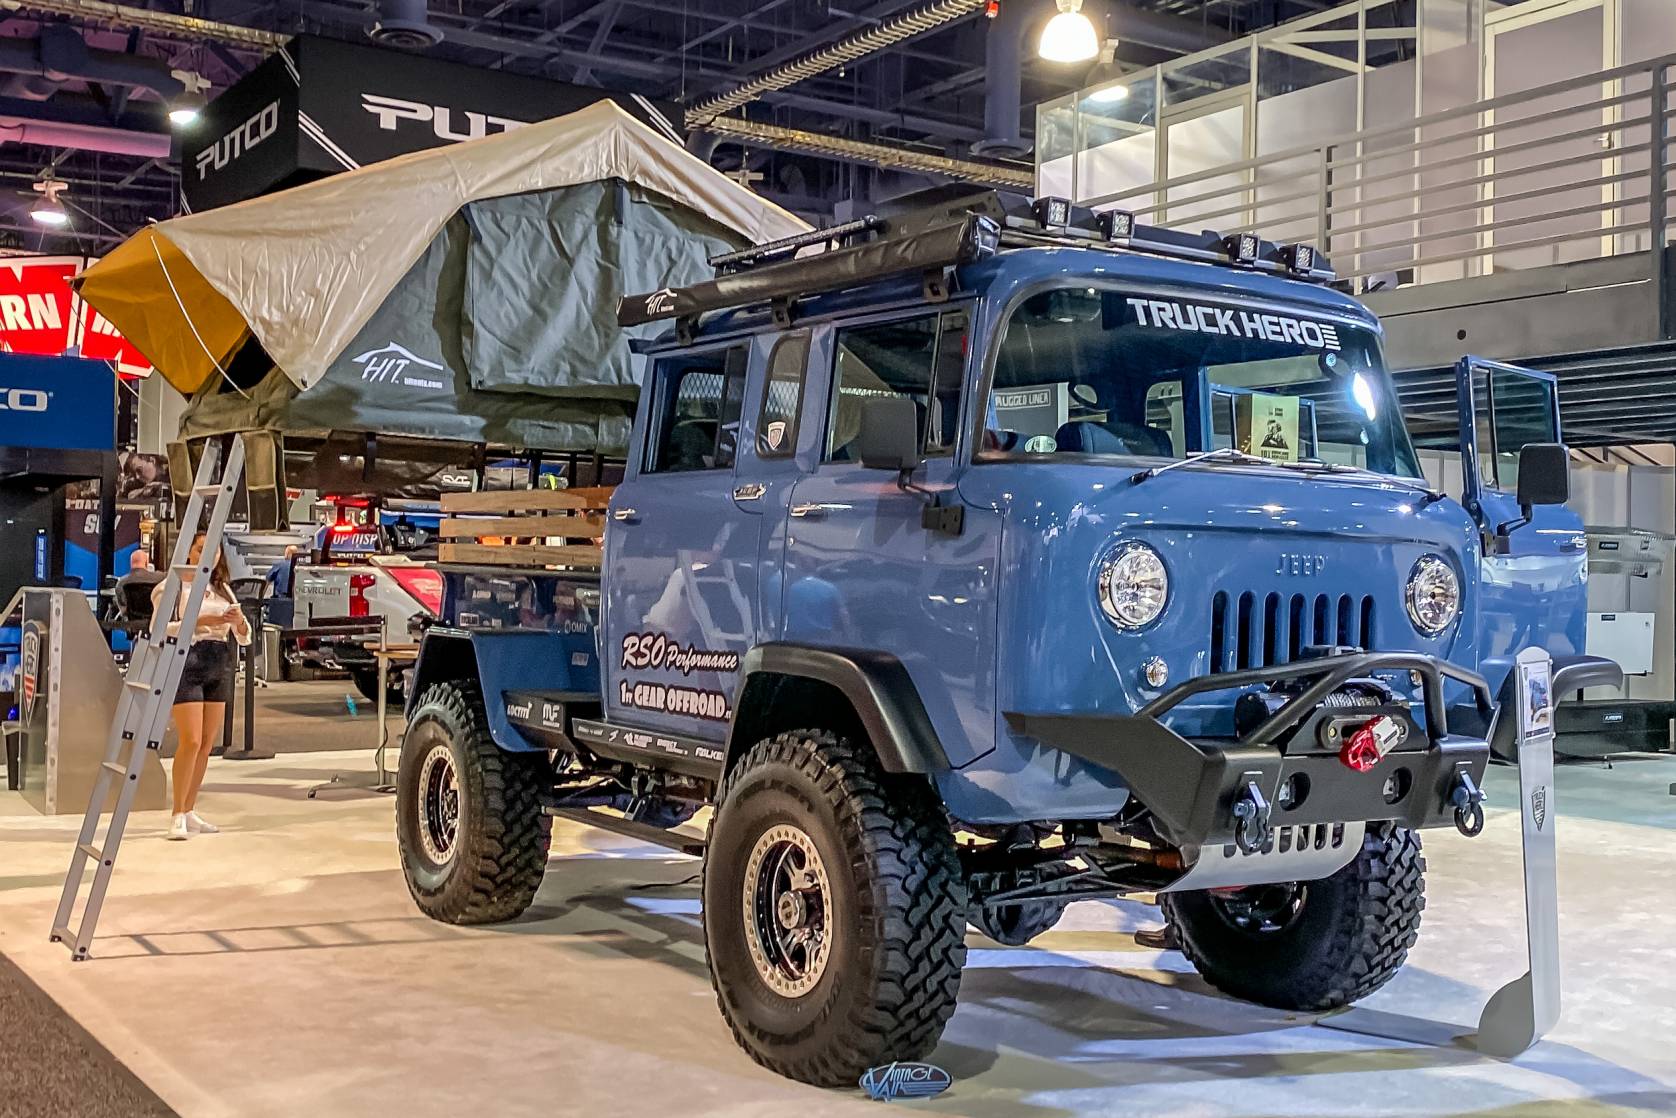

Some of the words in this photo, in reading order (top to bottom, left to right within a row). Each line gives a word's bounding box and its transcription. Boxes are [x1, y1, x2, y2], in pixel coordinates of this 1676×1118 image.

[196, 101, 278, 181] PUTCO
[1126, 298, 1241, 337] TRUCK
[1239, 311, 1326, 348] HERO
[361, 356, 410, 383] HIT
[1275, 553, 1326, 577] JEEP
[622, 635, 665, 667] RSO
[666, 644, 738, 673] Performance
[634, 684, 666, 710] GEAR
